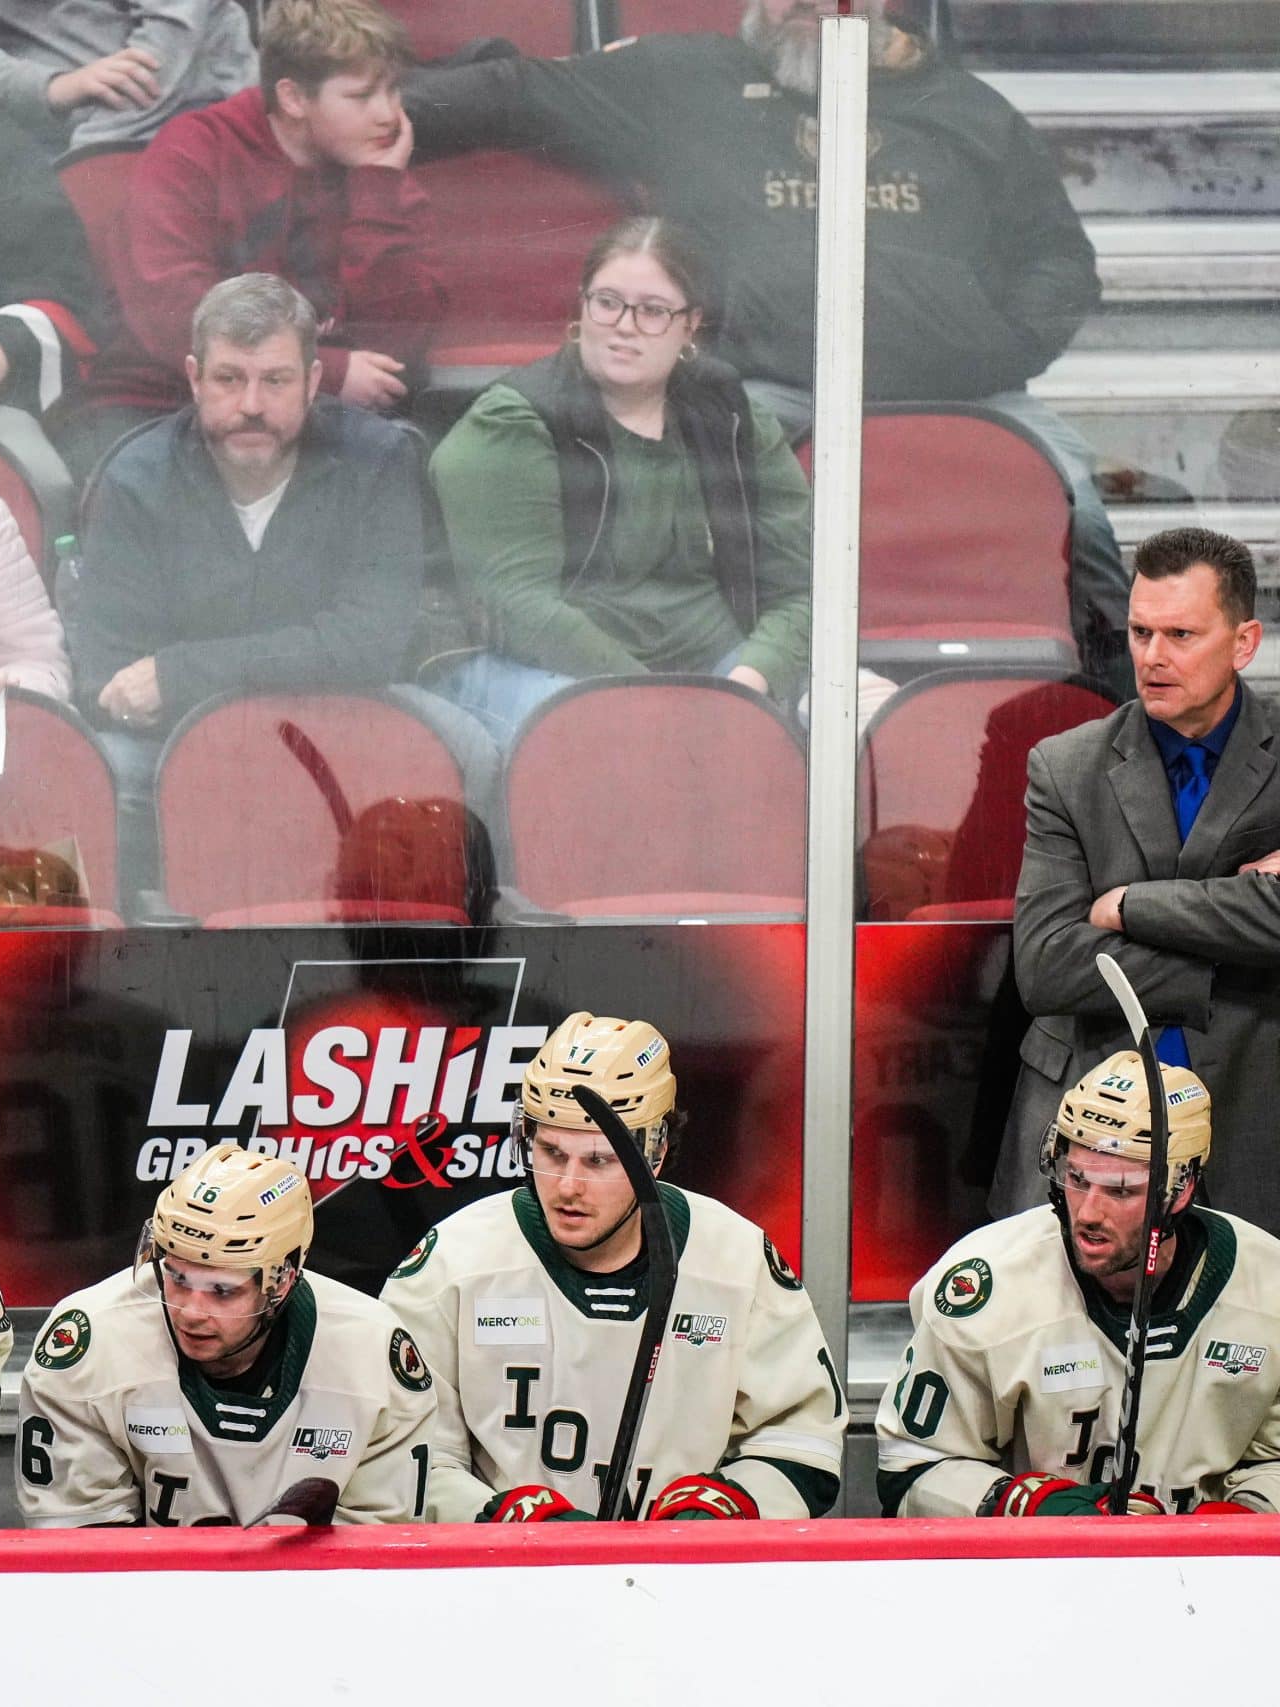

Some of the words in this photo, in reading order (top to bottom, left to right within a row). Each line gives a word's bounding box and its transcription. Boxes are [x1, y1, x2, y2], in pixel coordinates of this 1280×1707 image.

[766, 179, 920, 212] STEERS
[147, 1026, 548, 1127] LASHiE
[549, 1088, 575, 1100] CC
[1081, 1109, 1127, 1128] CCM
[171, 1221, 215, 1240] CCM
[1147, 1231, 1159, 1271] CCM
[1043, 1358, 1100, 1376] MERCYONE
[21, 1416, 55, 1486] 6
[411, 1444, 429, 1517] 1
